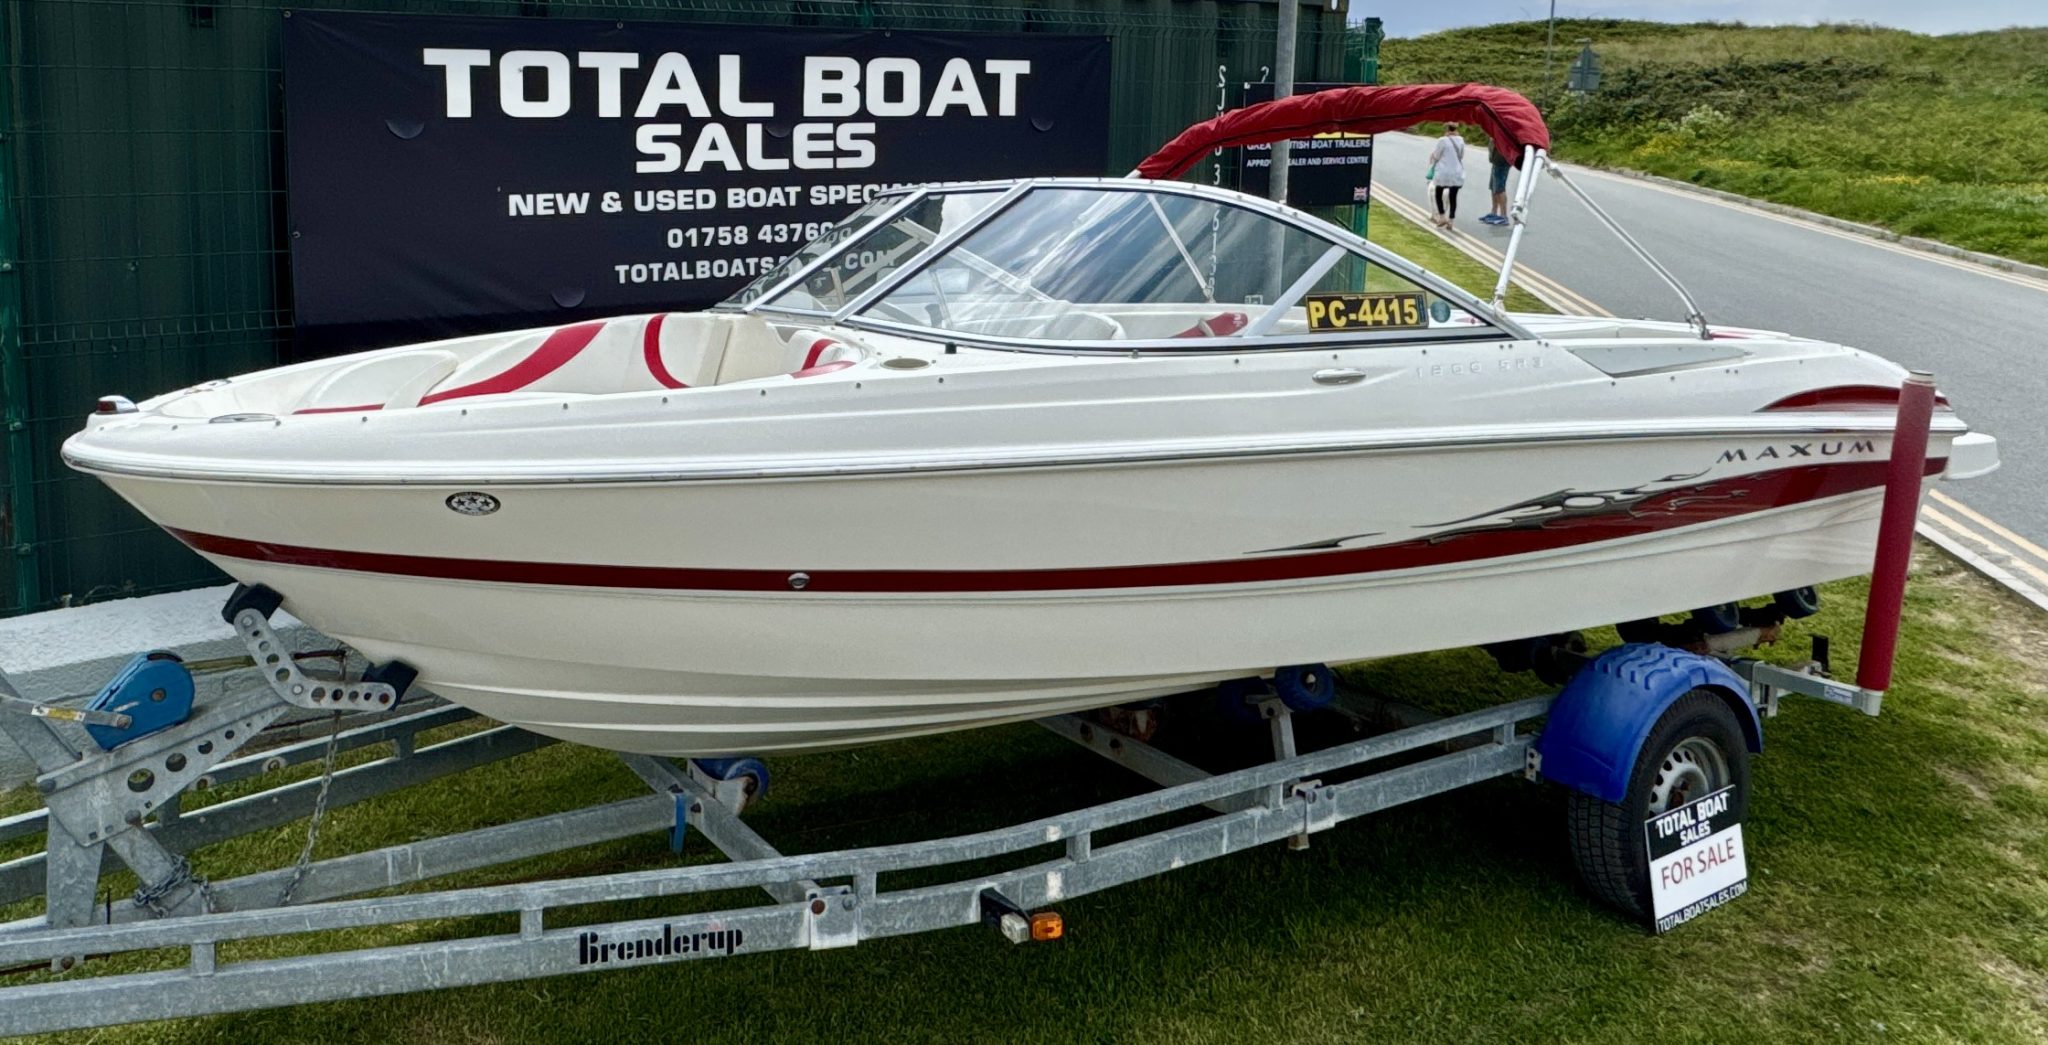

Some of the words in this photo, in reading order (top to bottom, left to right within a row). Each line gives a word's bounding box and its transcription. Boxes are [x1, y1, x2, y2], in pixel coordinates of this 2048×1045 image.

[423, 48, 774, 118] TOTAL
[803, 56, 1031, 117] BOAT
[635, 122, 876, 173] SALES
[1311, 139, 1333, 149] BOAT
[1334, 139, 1371, 148] TRAILERS
[1289, 157, 1306, 166] EALER
[1307, 157, 1321, 165] AND
[1322, 156, 1346, 165] SERVICE
[1346, 156, 1369, 164] CENTRE
[508, 192, 590, 216] NEW
[600, 191, 623, 213] &
[634, 188, 716, 212] USED
[727, 186, 801, 209] BOAT
[667, 225, 749, 248] 01758
[1309, 299, 1418, 328] PC-4415
[1716, 440, 1875, 464] MAXUM
[1656, 809, 1697, 839] TOTAL
[1697, 792, 1730, 822] BOAT
[1680, 821, 1711, 846] SALES
[1661, 856, 1695, 890] FOR
[1698, 837, 1735, 873] SALE
[1658, 881, 1748, 933] TOTALBOATSALES.COM
[579, 923, 743, 965] Brenderup
